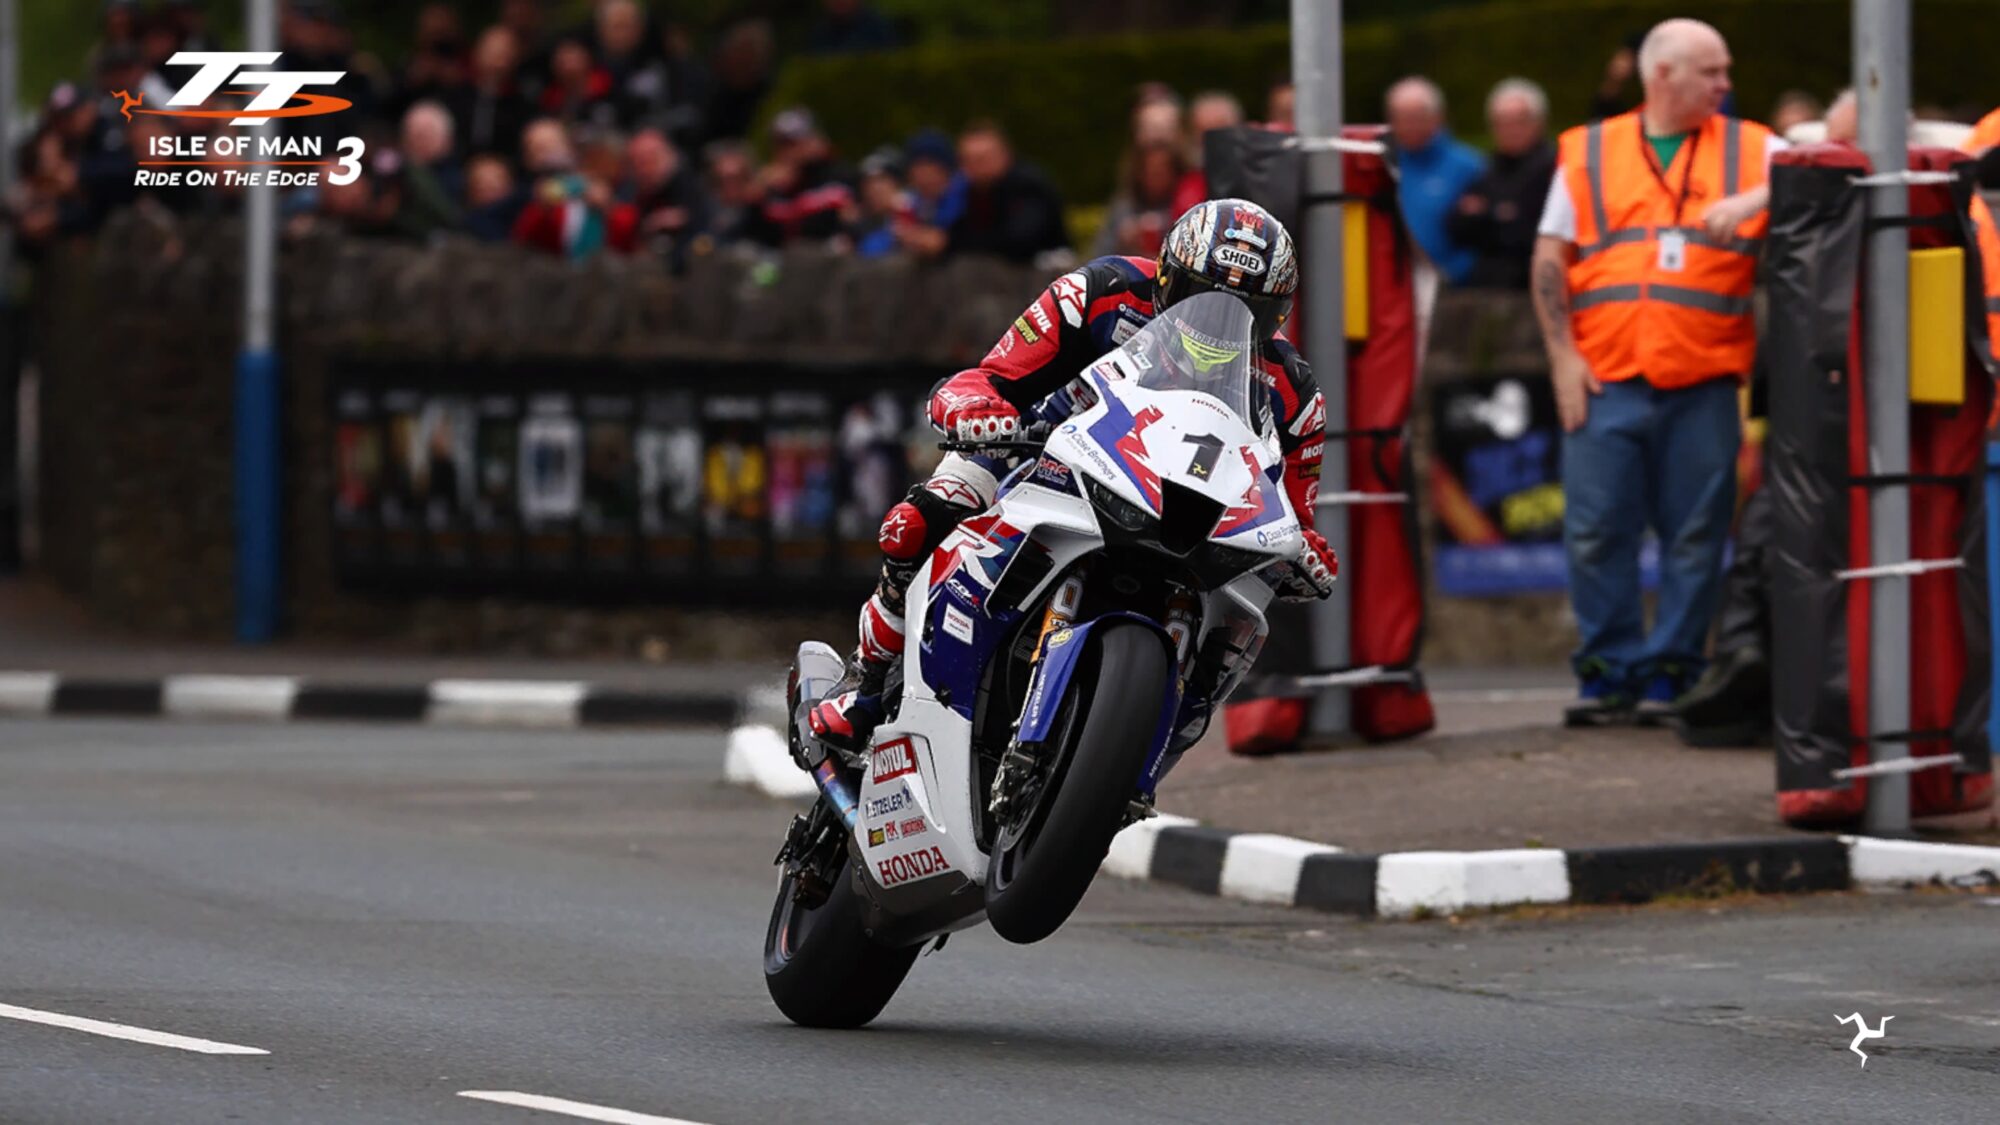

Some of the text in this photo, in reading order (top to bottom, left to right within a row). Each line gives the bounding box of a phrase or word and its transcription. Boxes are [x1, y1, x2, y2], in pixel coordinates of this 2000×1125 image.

[1220, 249, 1261, 271] SHOEI
[1029, 302, 1053, 334] OTUL
[1182, 432, 1226, 483] 1
[873, 743, 913, 779] MOTUL
[877, 845, 950, 888] HONDA
